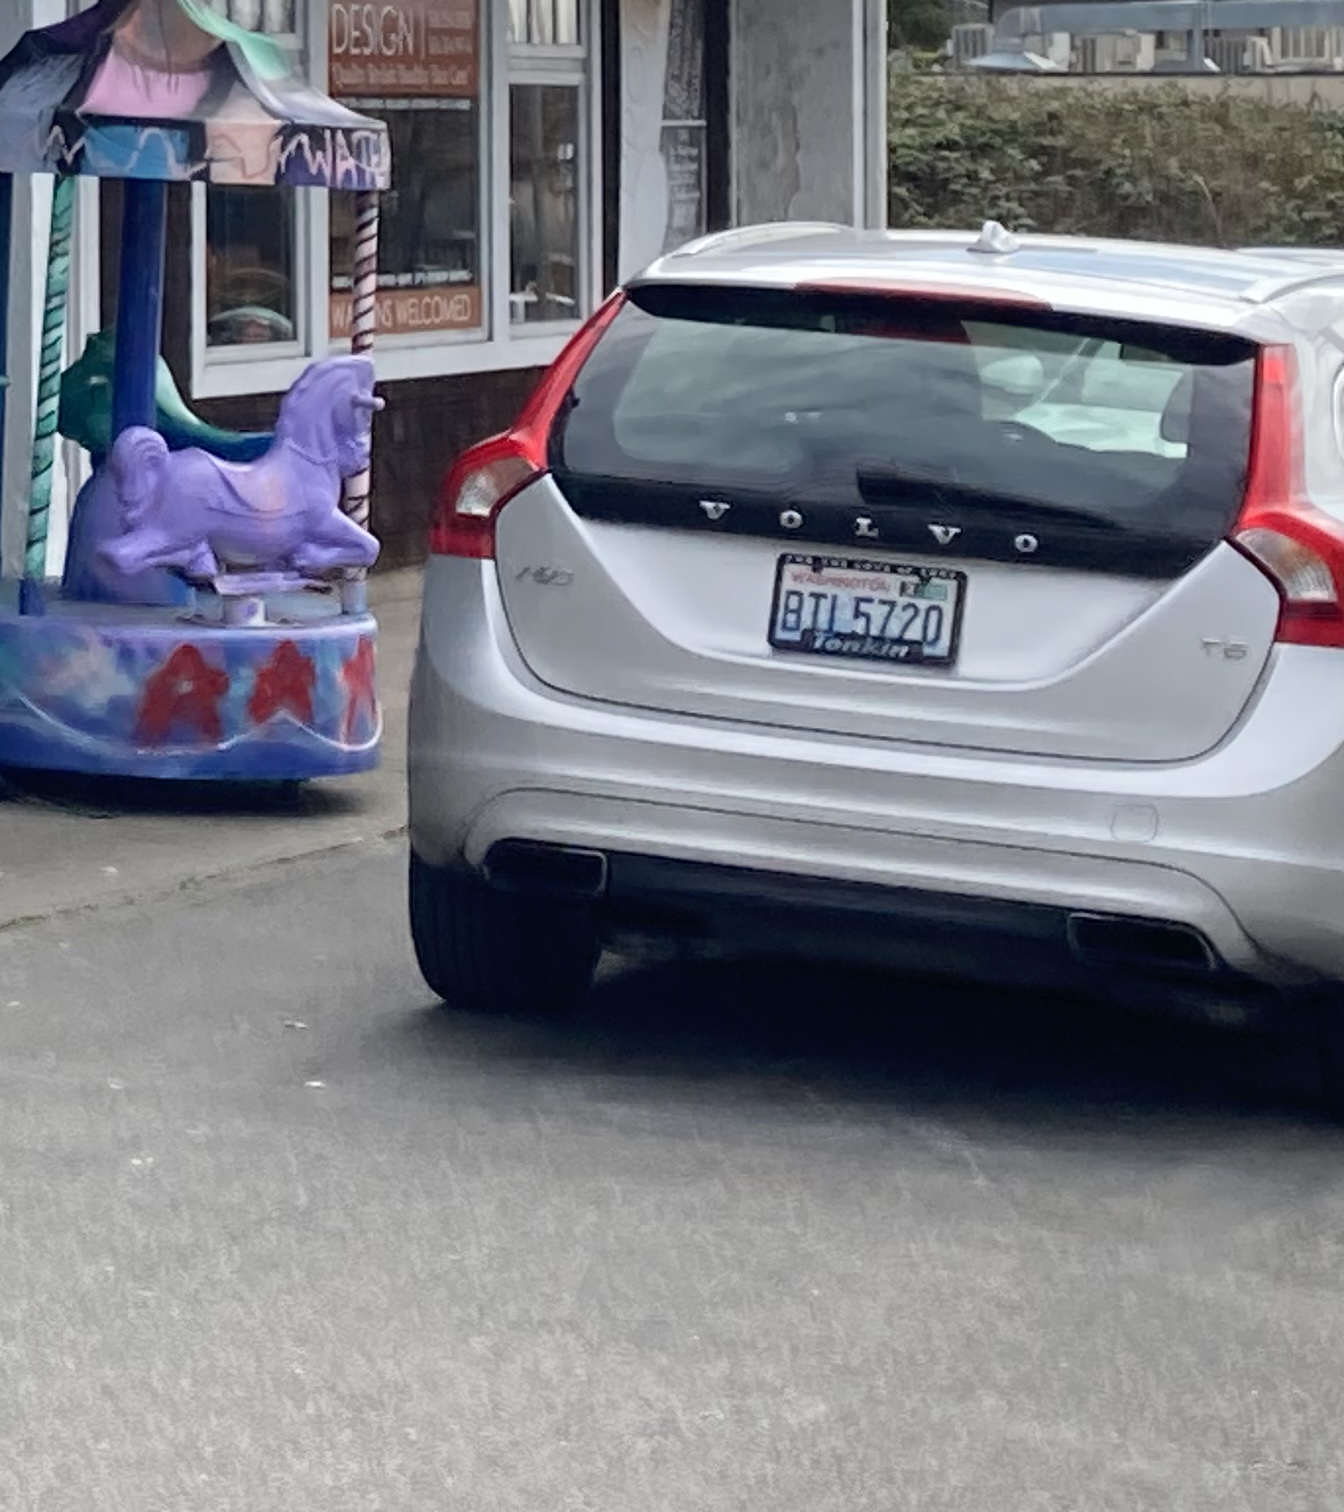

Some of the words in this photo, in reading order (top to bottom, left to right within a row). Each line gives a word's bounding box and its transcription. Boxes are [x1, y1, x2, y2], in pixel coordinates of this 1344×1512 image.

[331, 3, 414, 57] DESIGN
[395, 293, 472, 326] WELCOMED
[698, 499, 1039, 553] VOLVO
[812, 634, 910, 658] Tonkin
